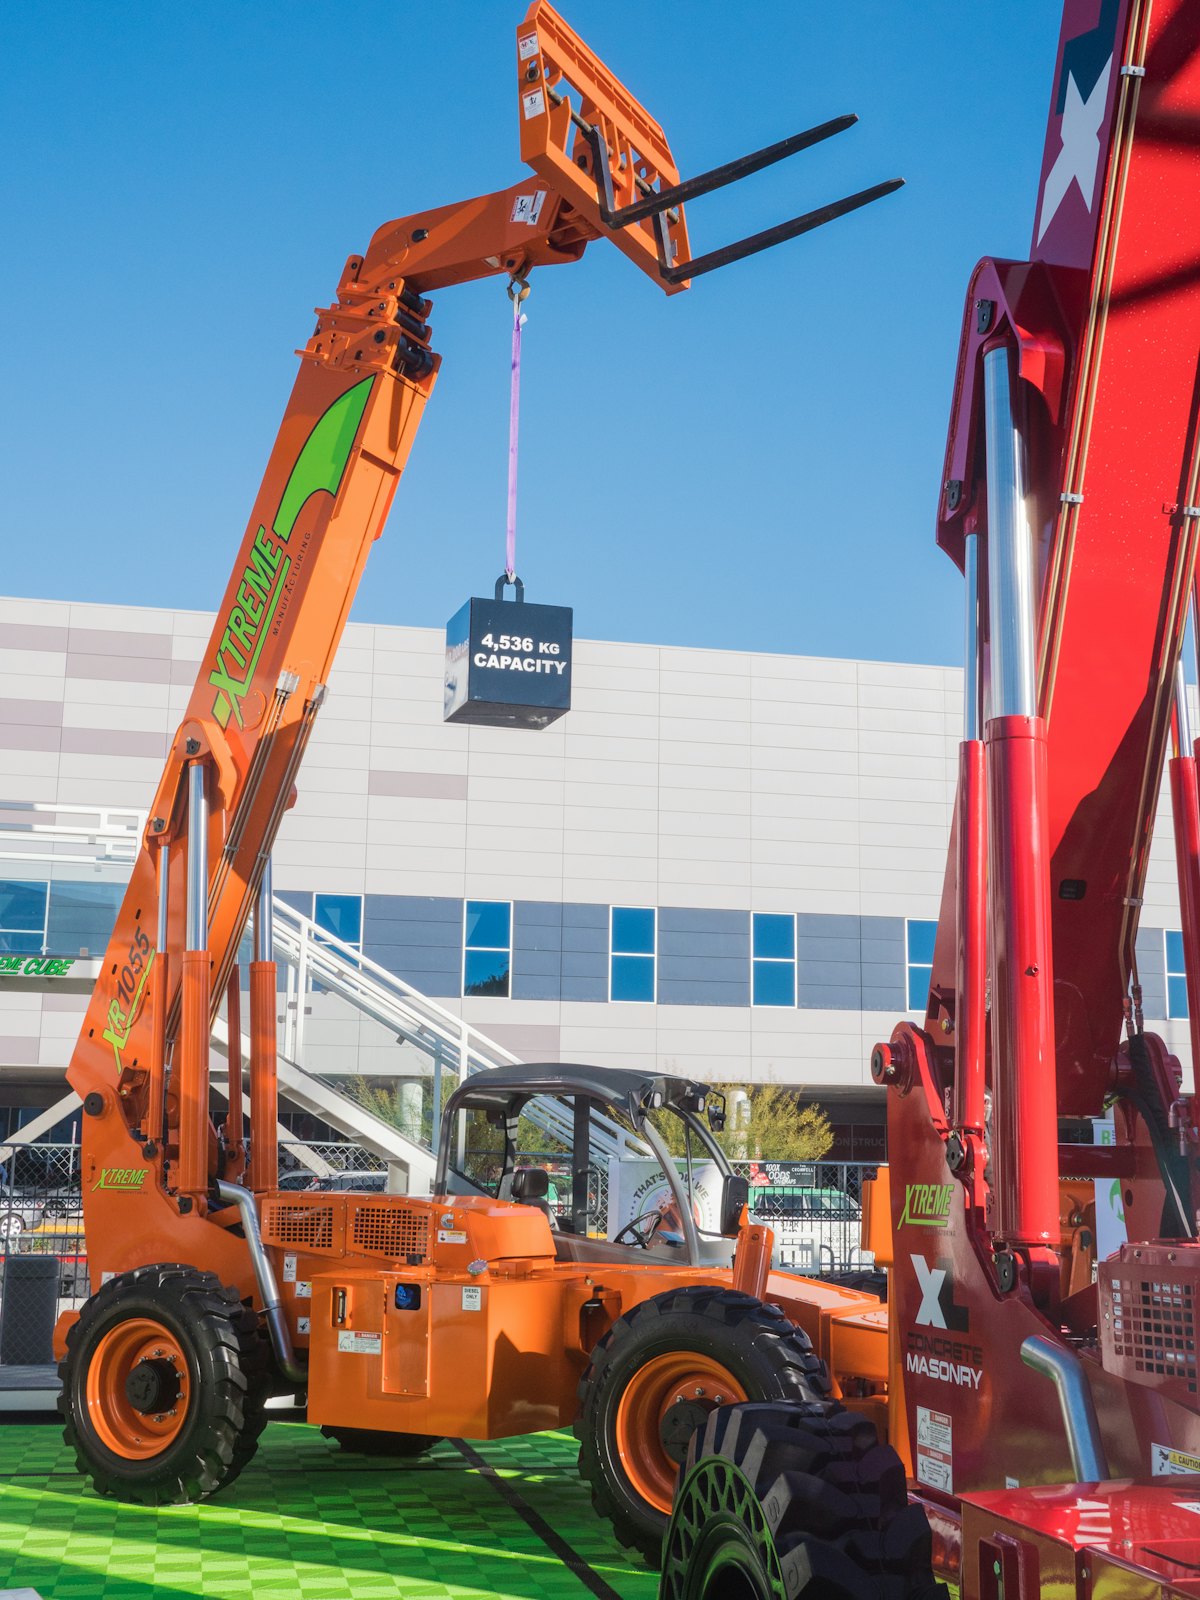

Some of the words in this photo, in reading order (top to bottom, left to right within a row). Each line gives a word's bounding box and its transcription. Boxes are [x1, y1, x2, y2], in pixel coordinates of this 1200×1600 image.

[272, 532, 311, 637] MANUFACTURING
[208, 523, 289, 731] XTREME
[481, 633, 534, 652] 4,536
[539, 642, 560, 655] KG
[473, 653, 567, 675] CAPACITY
[23, 957, 76, 976] CUBE
[835, 1136, 885, 1147] ONSTRUC
[91, 1168, 149, 1192] XTREME
[768, 1171, 791, 1180] ODDS
[694, 1181, 709, 1201] WE
[897, 1184, 955, 1231] XTREME
[909, 1253, 969, 1333] XL
[906, 1351, 983, 1390] MASONRY
